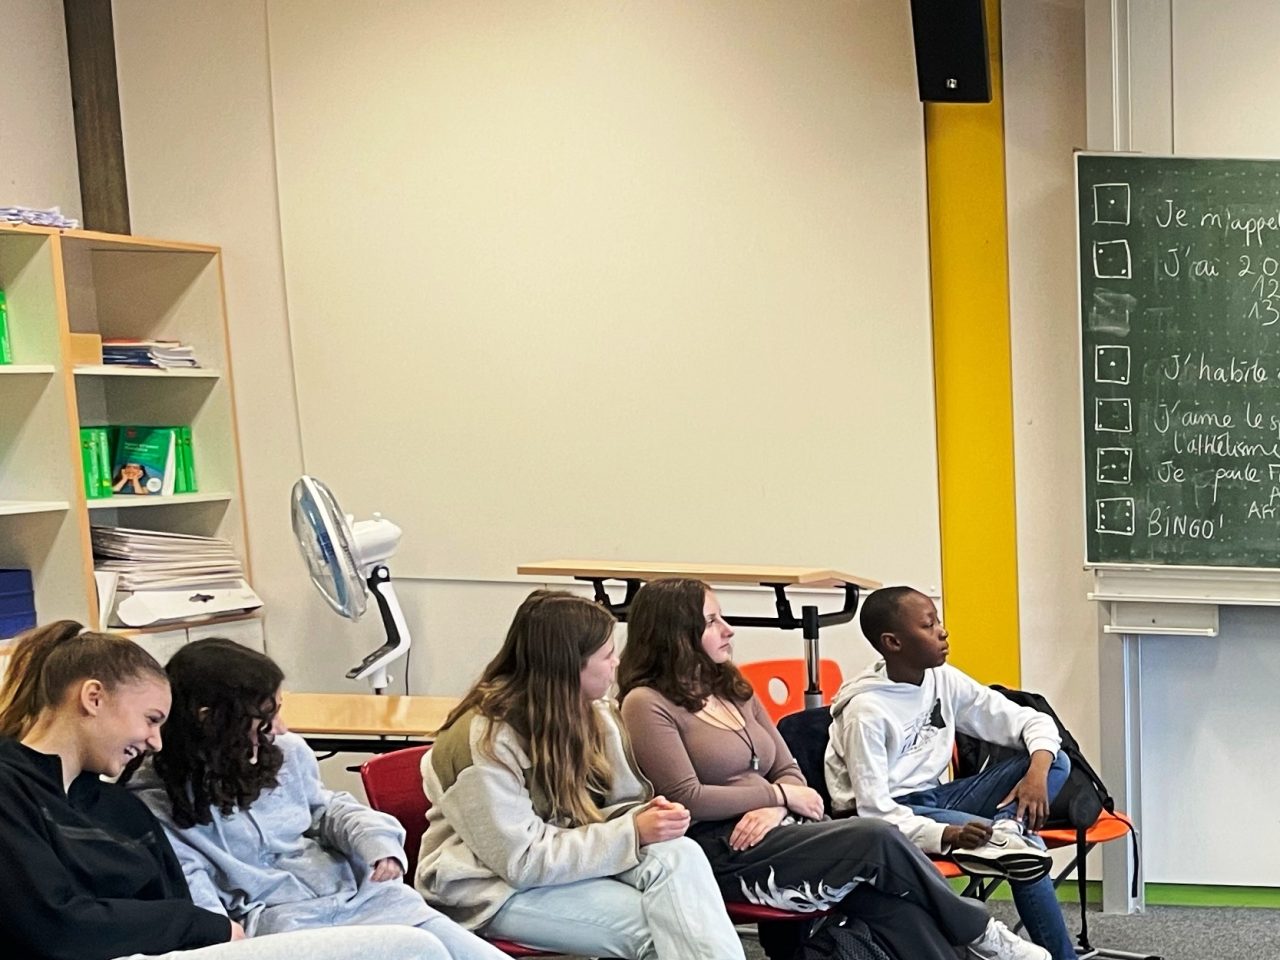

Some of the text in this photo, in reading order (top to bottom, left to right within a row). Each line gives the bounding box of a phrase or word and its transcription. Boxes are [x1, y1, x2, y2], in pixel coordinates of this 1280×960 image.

[1156, 199, 1188, 229] Je
[1164, 246, 1219, 278] J'ai
[1248, 300, 1280, 326] 13
[1165, 352, 1268, 382] J'habite
[1154, 402, 1236, 433] J'aime
[1246, 402, 1264, 429] le
[1158, 461, 1186, 482] Je
